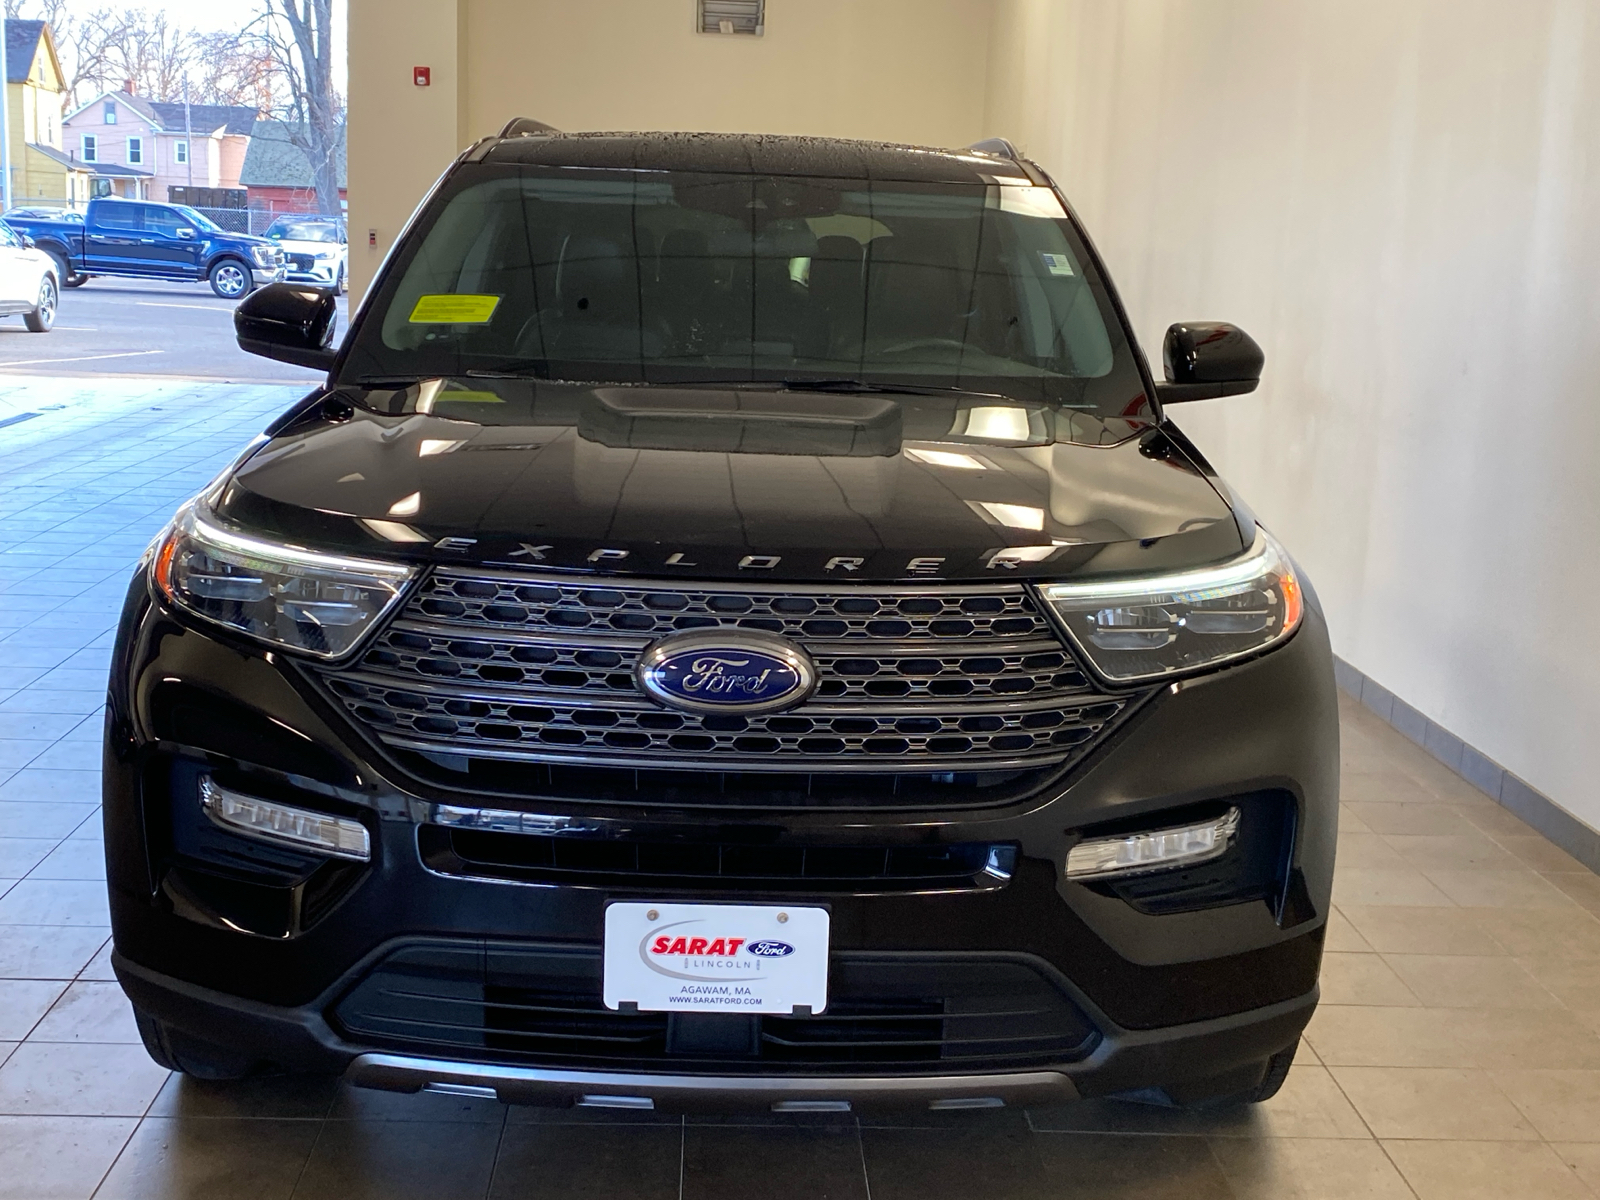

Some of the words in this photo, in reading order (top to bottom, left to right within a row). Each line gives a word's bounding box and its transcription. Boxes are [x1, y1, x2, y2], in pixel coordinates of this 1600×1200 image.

[434, 536, 1022, 574] EXPLORER
[682, 657, 771, 694] Ford
[650, 935, 747, 957] SARAT
[754, 942, 787, 956] Ford
[694, 960, 751, 969] LINCOLN
[680, 986, 732, 996] AGAWAM,
[735, 986, 751, 995] MA
[669, 996, 762, 1005] WWW.SARATFORD.COM
